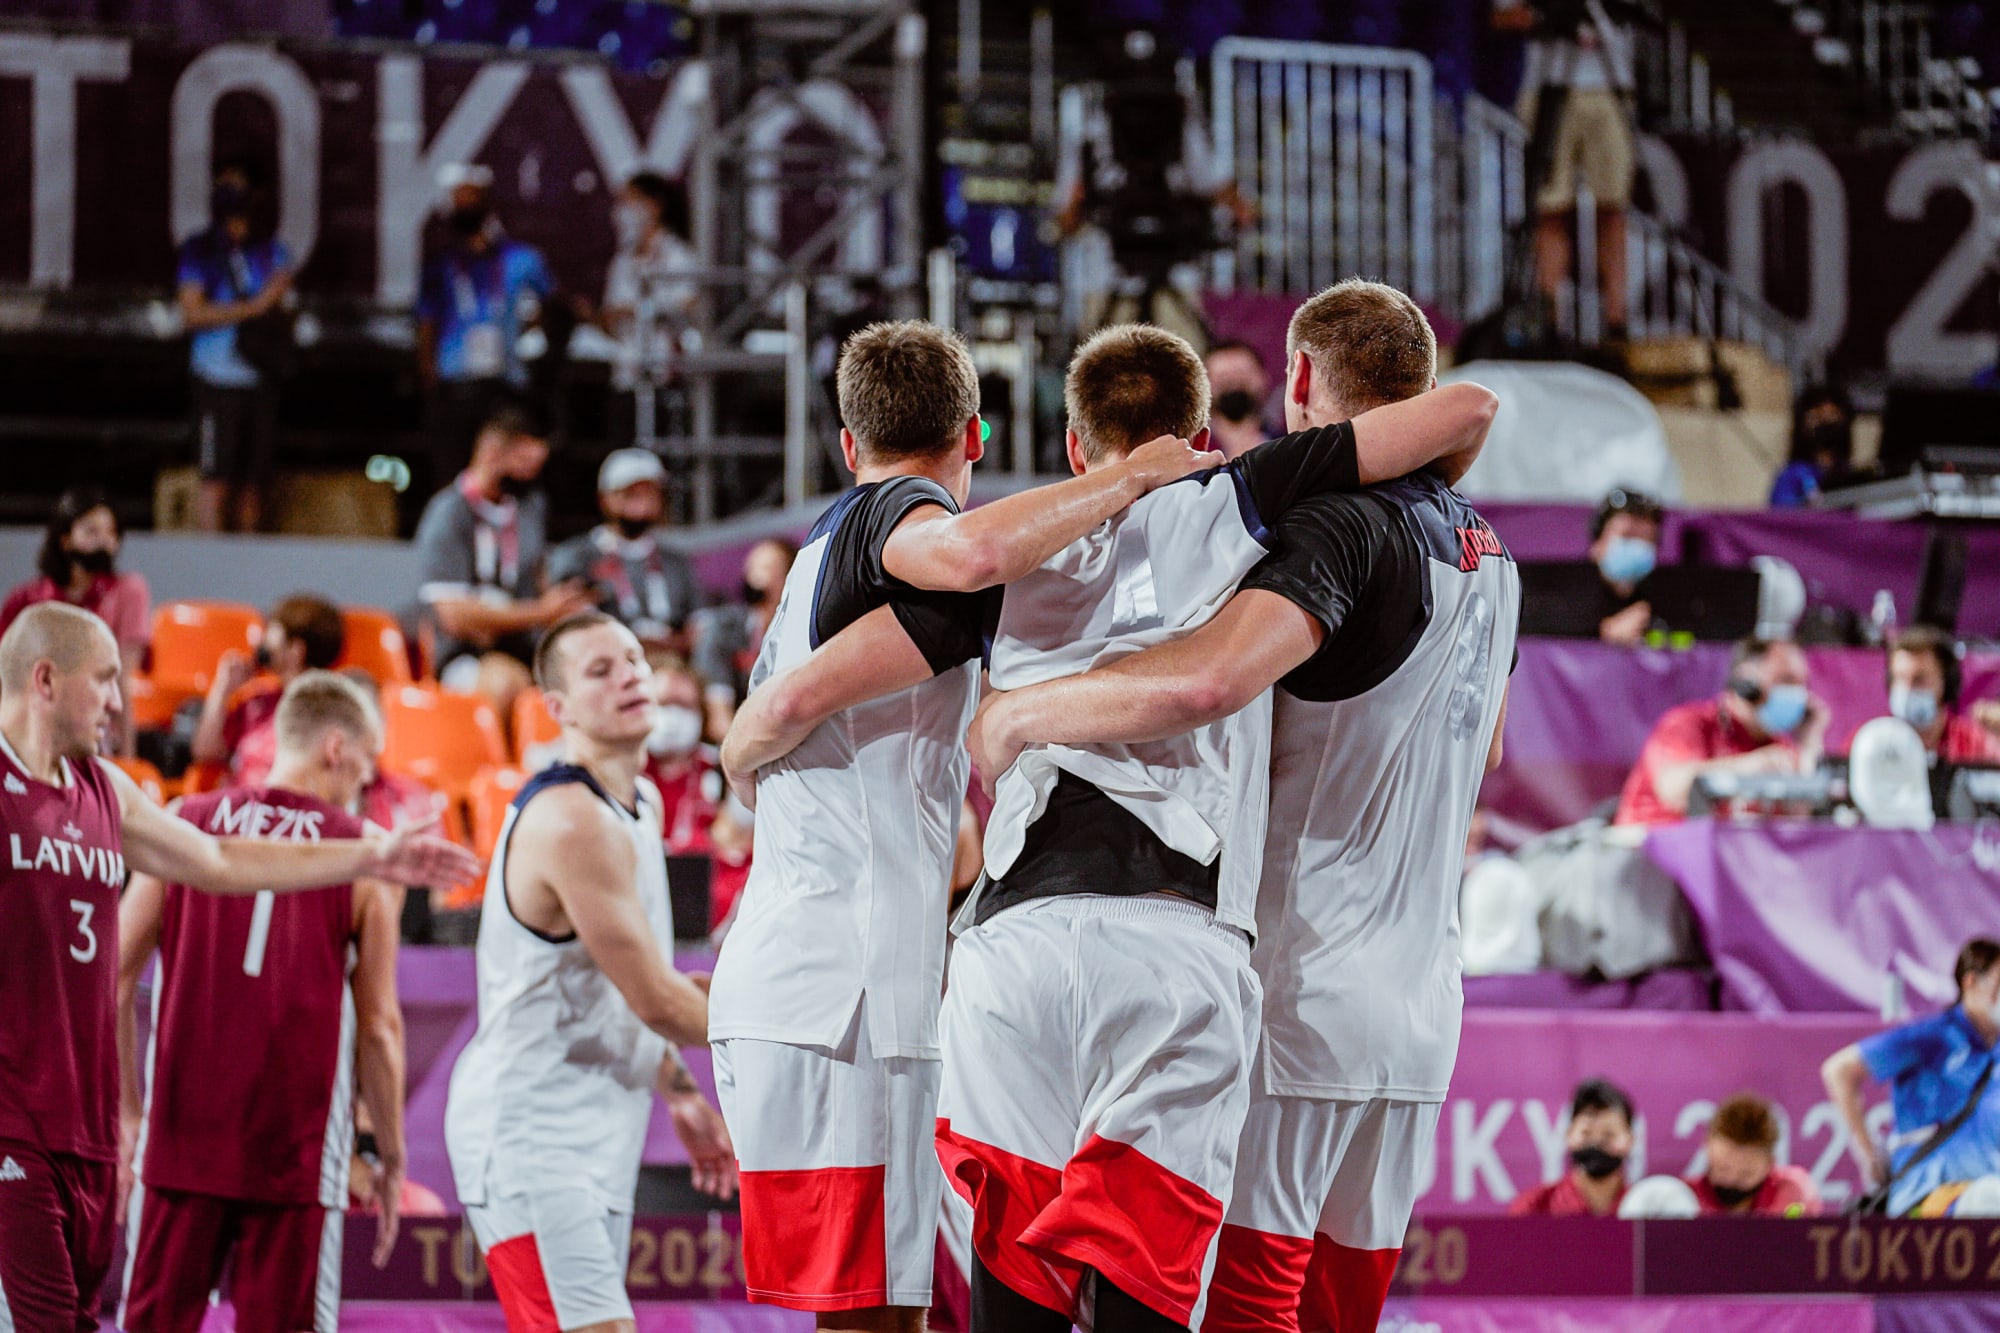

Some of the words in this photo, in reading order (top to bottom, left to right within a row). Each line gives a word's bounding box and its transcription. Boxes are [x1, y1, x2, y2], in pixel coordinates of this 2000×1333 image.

[0, 36, 884, 312] TOKYO
[70, 899, 97, 964] 3
[1807, 1226, 1976, 1282] TOKYO
